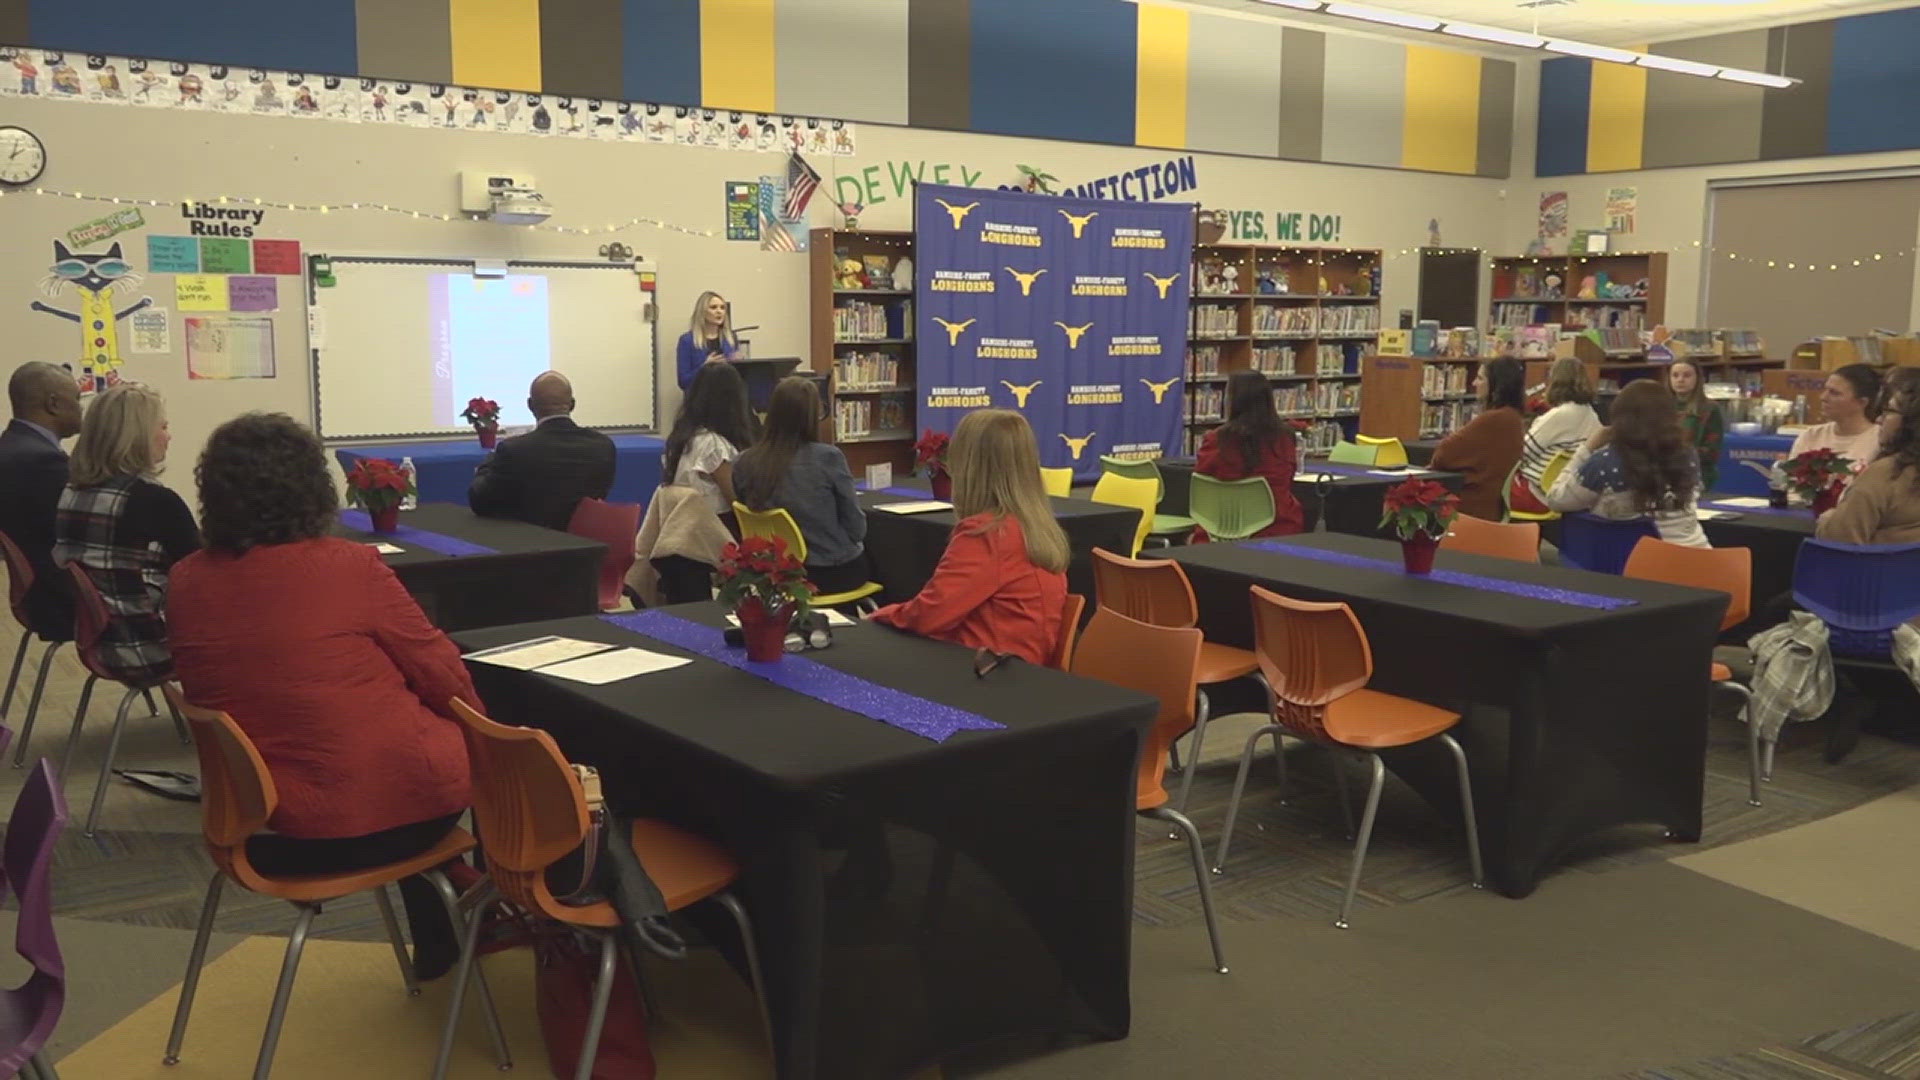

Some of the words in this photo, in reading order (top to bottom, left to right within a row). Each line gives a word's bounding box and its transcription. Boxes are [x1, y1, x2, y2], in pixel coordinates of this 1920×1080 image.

[1053, 156, 1197, 203] FICTION
[182, 202, 264, 226] Library
[190, 220, 254, 238] Rules
[1229, 210, 1268, 242] YES,
[1276, 212, 1302, 241] WE
[1308, 213, 1341, 242] DO!
[980, 231, 1042, 247] LONGHORNS
[1111, 236, 1166, 248] LONGHORNS
[931, 279, 995, 293] LONGHORNS
[1071, 284, 1128, 296] LONGHORNS
[976, 346, 1038, 359] LONGHORNS
[1108, 344, 1162, 356] LONGHORNS
[927, 395, 991, 408] LONGHORNS
[1067, 393, 1123, 404] LONGHORNS
